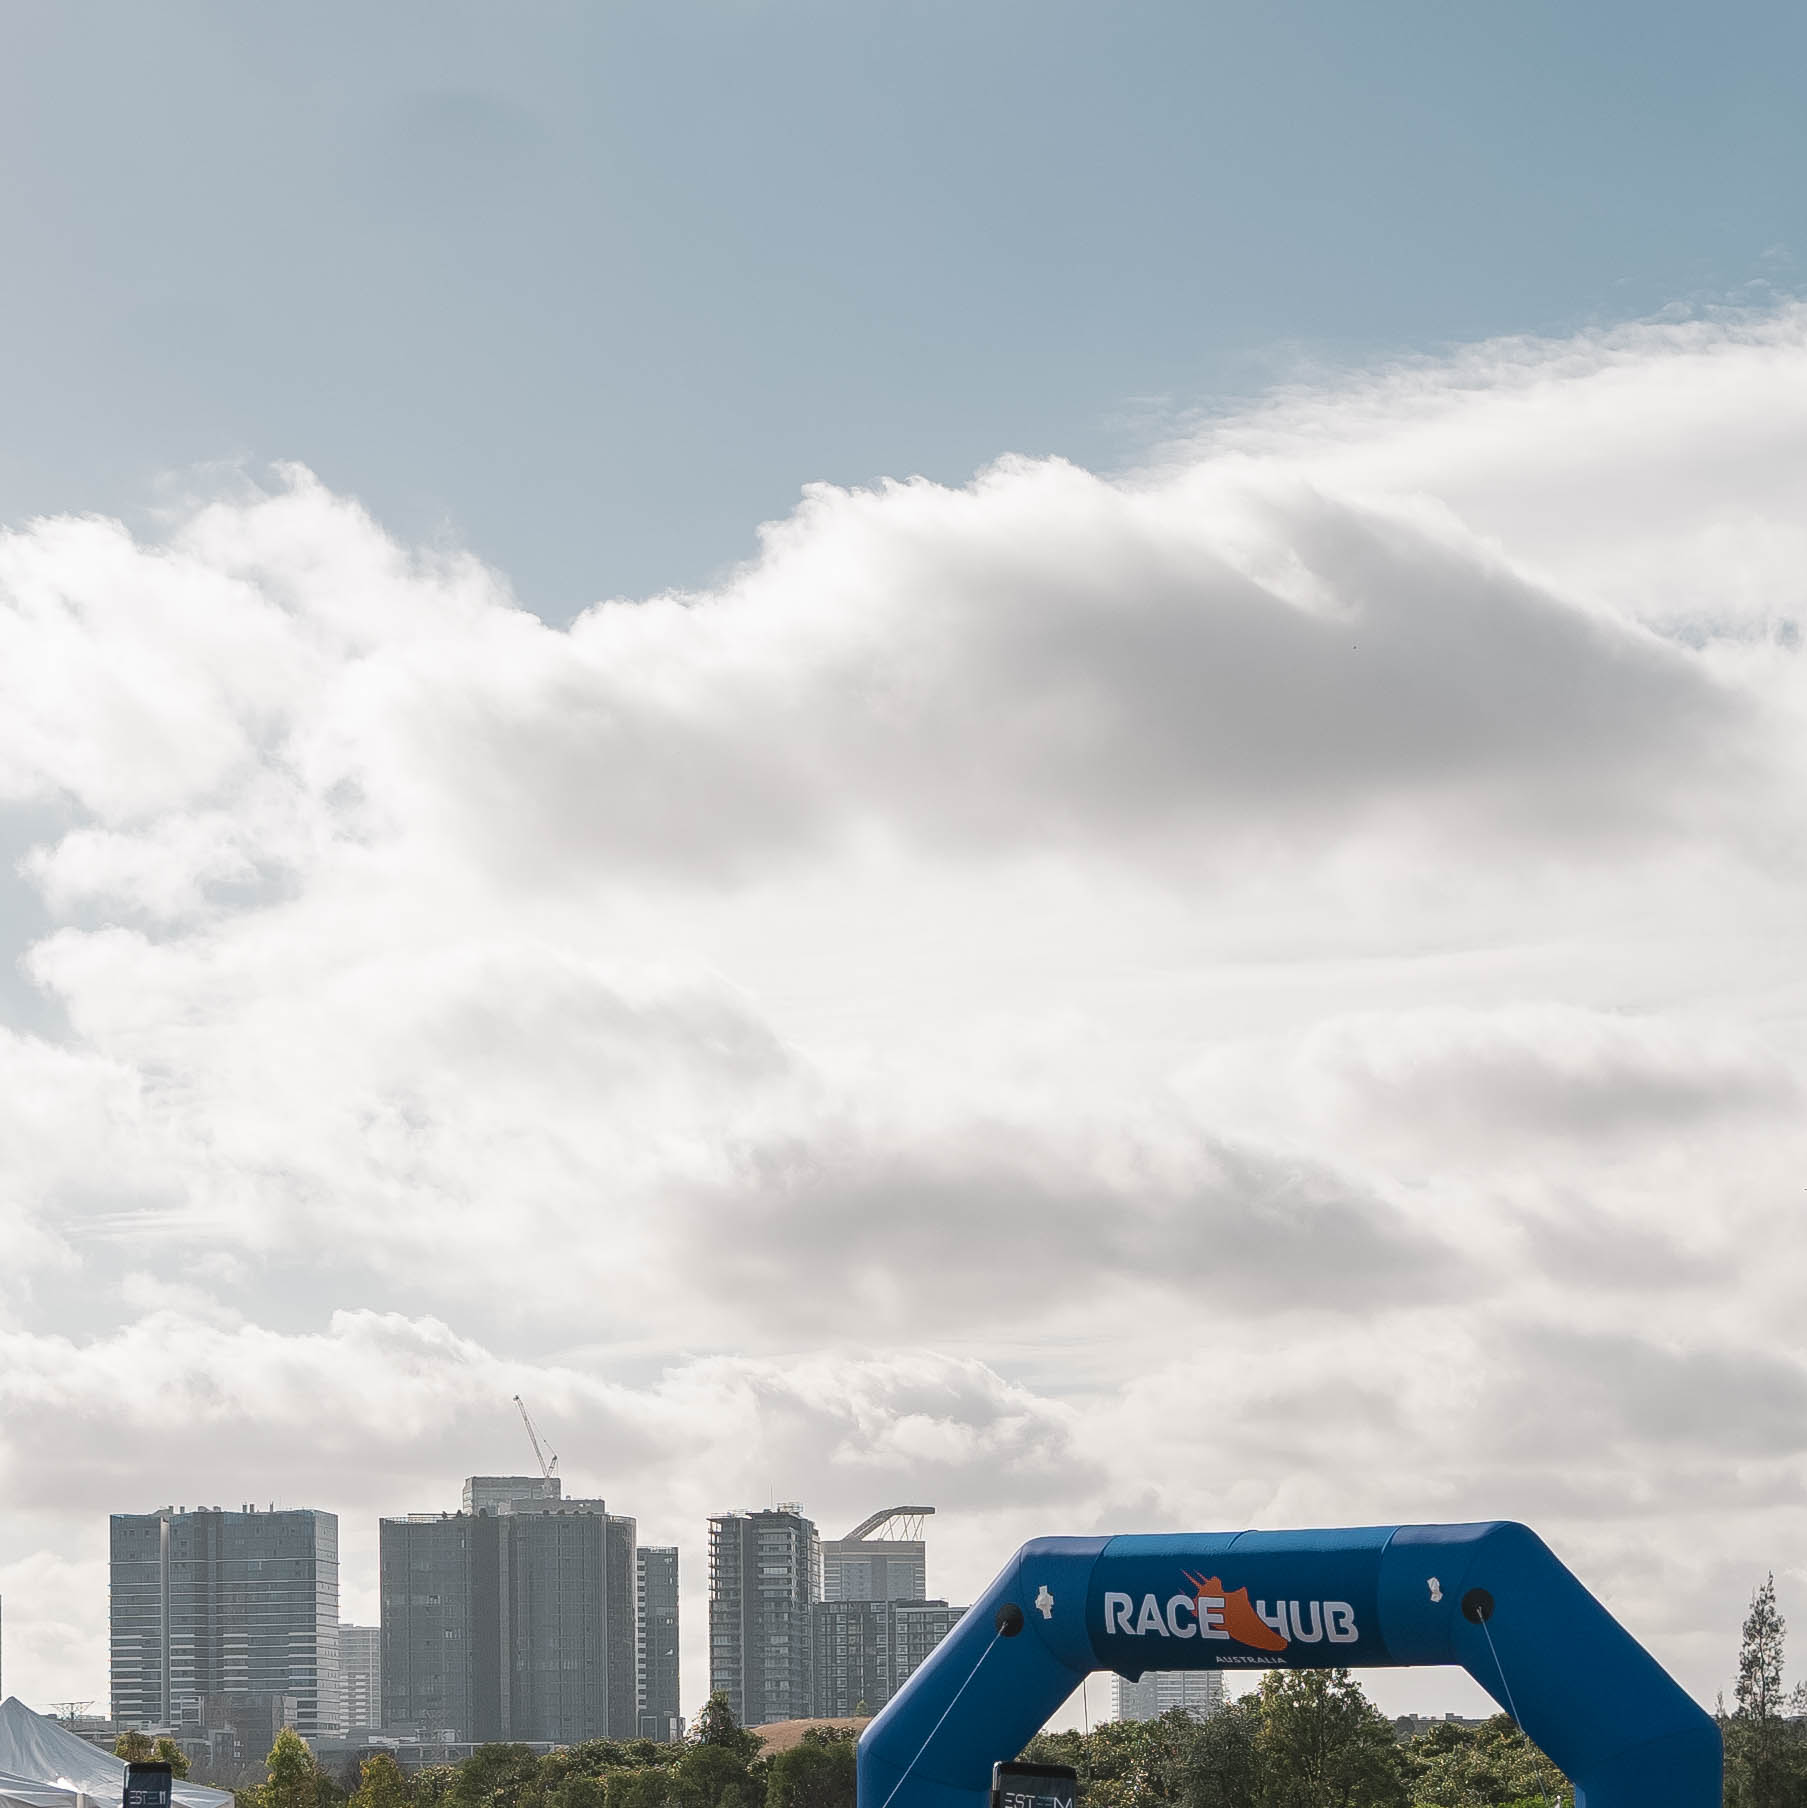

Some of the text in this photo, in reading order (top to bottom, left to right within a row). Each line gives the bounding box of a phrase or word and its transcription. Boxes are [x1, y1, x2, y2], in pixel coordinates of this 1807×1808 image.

[1105, 1591, 1359, 1643] RACE HUB
[1215, 1655, 1288, 1665] AUSTRALIA
